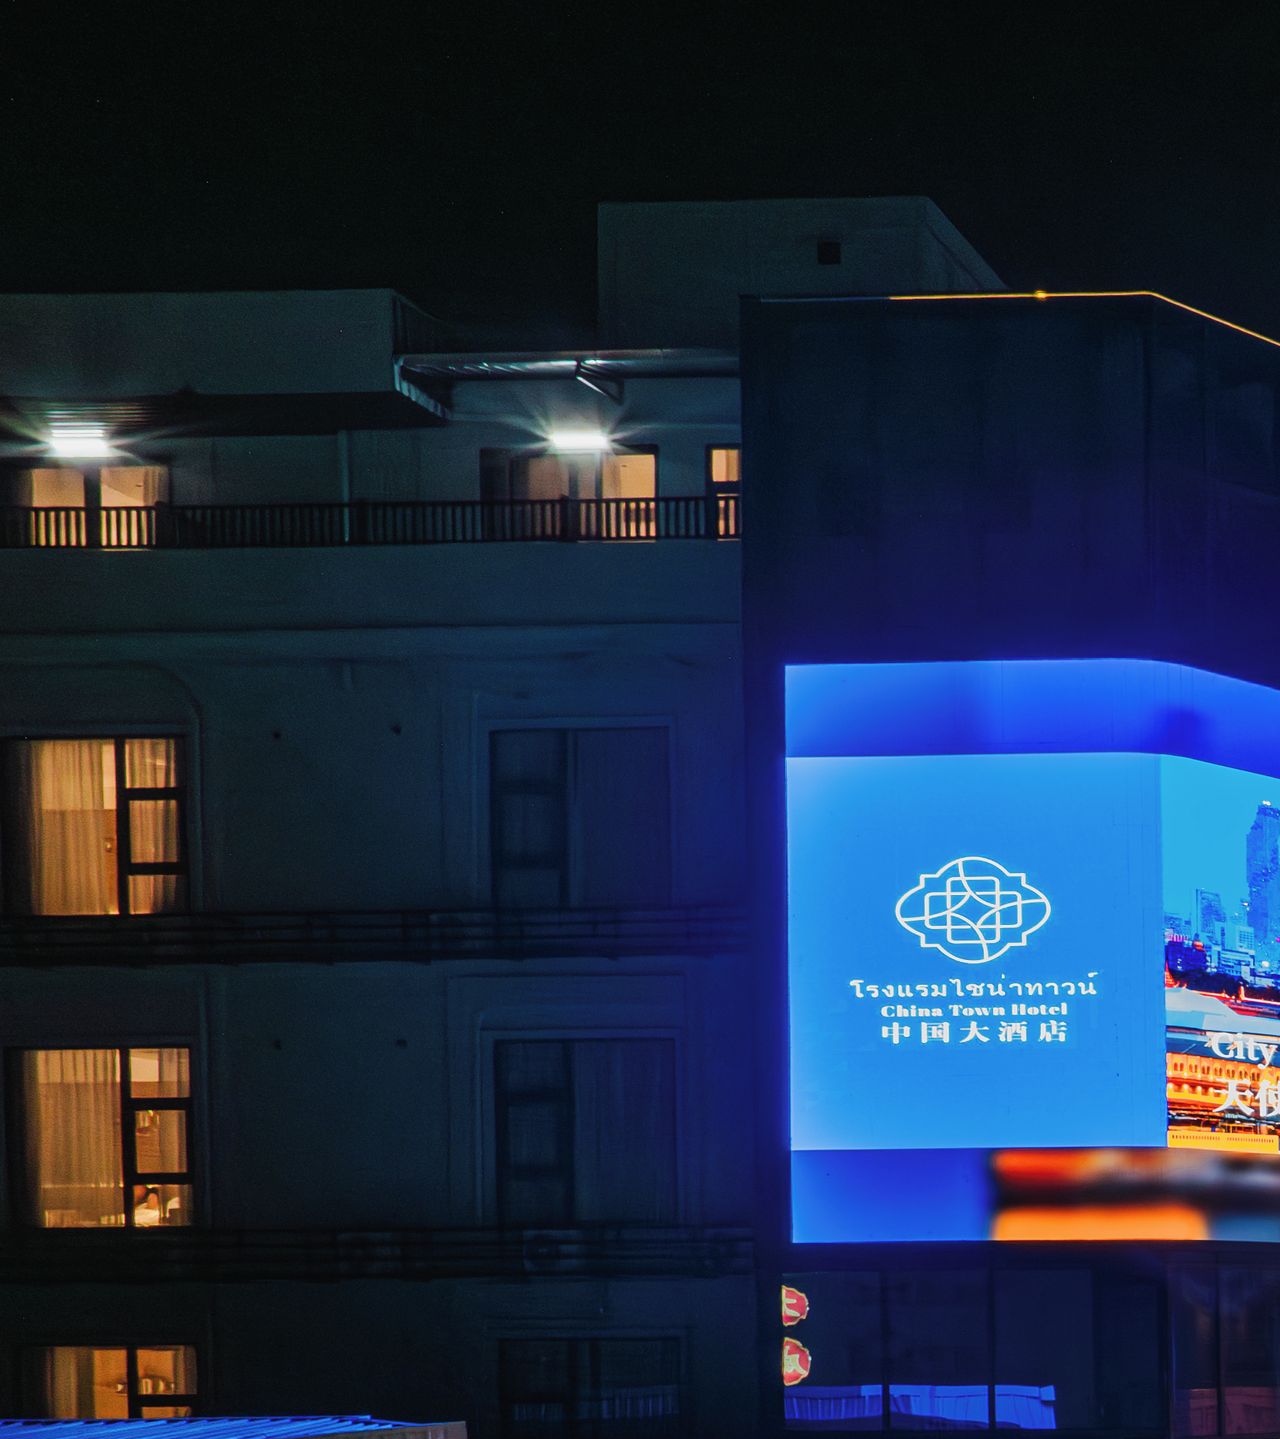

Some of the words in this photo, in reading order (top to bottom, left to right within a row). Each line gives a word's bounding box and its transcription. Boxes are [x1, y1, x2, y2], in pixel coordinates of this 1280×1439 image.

[850, 971, 1098, 998] โรงแรมไชน่าทาวน์
[881, 1003, 943, 1017] China
[949, 1004, 1006, 1017] Town
[1012, 1002, 1067, 1016] Hotel
[881, 1021, 1067, 1043] 中国大酒店
[1209, 1033, 1278, 1068] City
